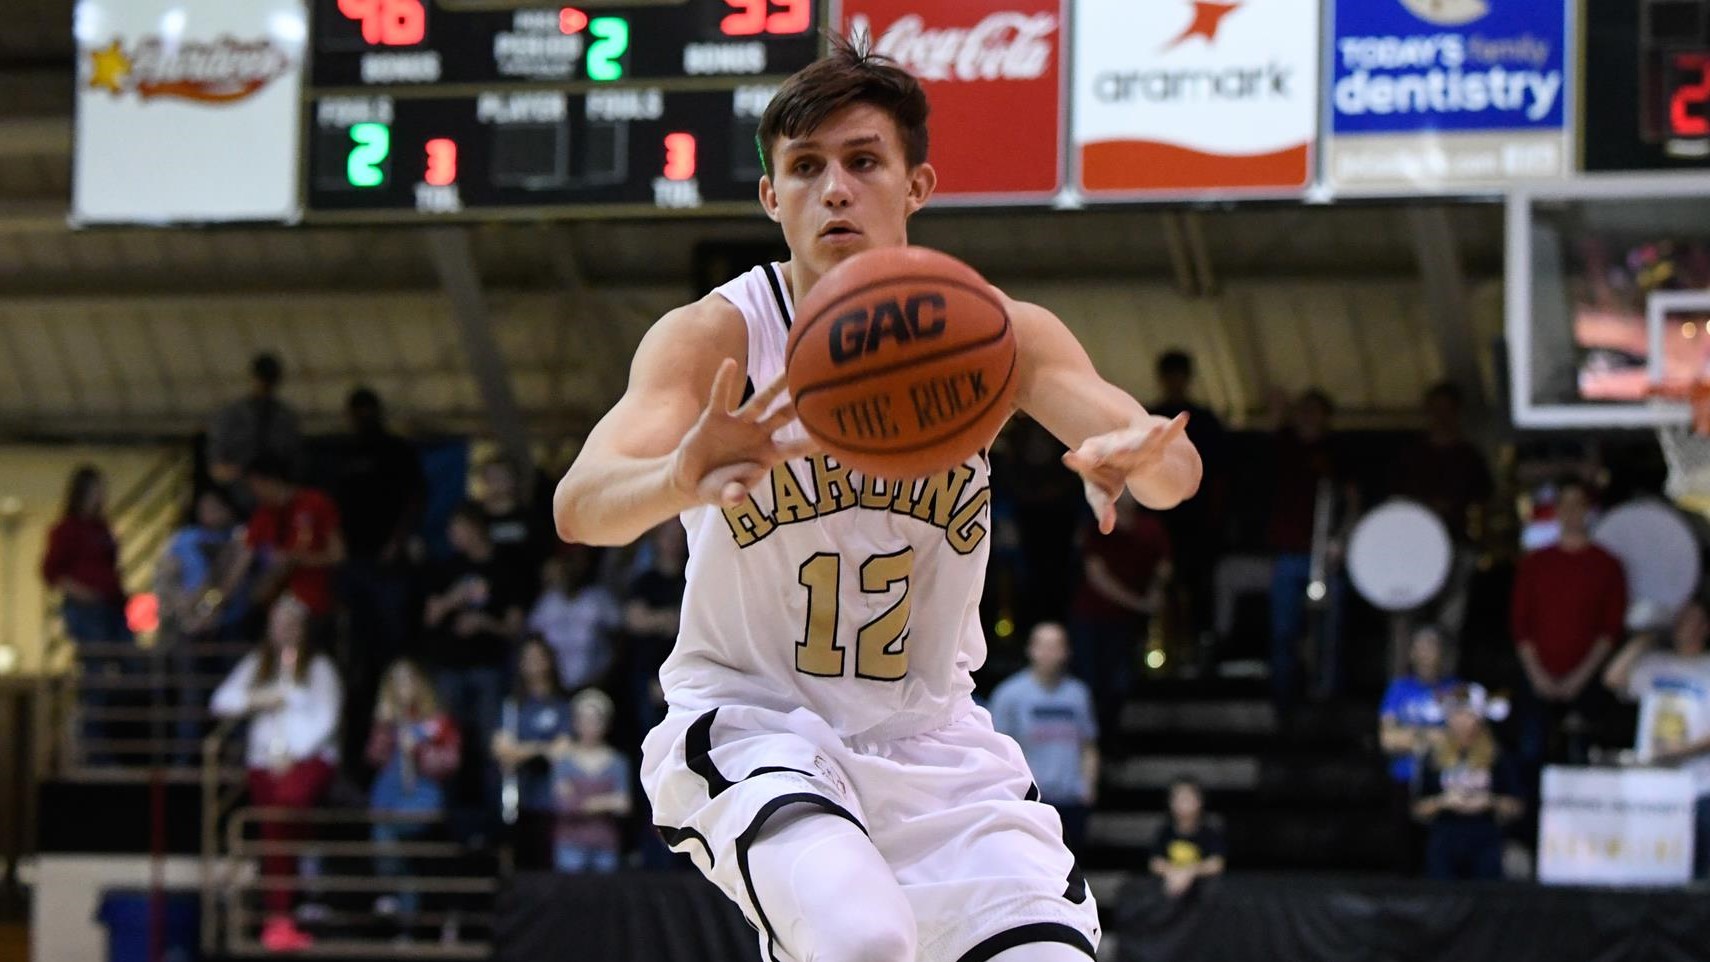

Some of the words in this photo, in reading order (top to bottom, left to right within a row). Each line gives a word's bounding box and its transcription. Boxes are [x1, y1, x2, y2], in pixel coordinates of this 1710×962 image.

[587, 17, 629, 81] 2
[683, 42, 767, 75] BONUS
[1093, 60, 1296, 104] aramark
[1335, 65, 1561, 121] dentistry
[347, 122, 390, 187] 2
[425, 138, 457, 186] 3
[664, 132, 696, 180] 3
[828, 292, 946, 365] GAC
[831, 393, 899, 439] THE
[908, 368, 989, 432] ROCK
[795, 544, 914, 681] 12
